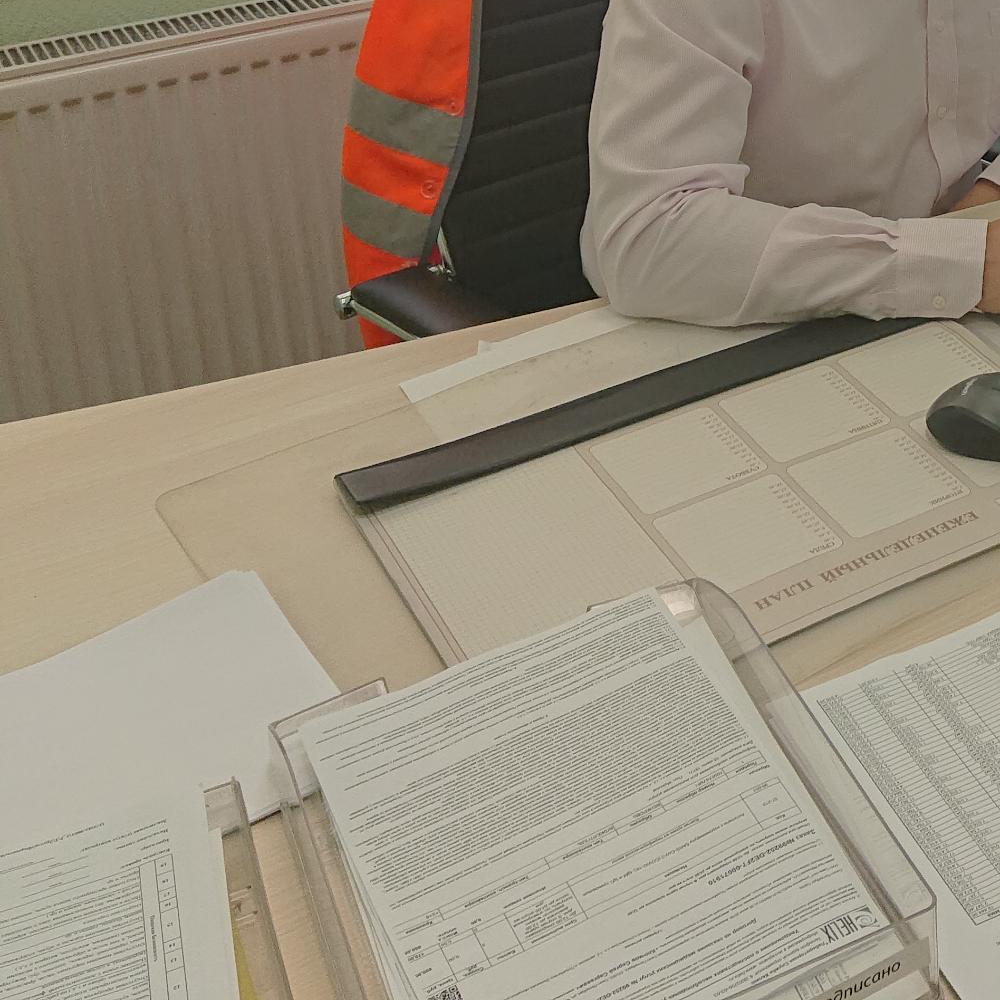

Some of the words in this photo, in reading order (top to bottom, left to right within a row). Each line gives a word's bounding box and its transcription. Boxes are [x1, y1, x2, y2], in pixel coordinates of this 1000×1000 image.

[820, 510, 979, 584] ЕЖЕНЕДЕЛЬНЫЙ
[753, 578, 816, 610] ПЛАН
[820, 914, 858, 944] HELIX
[827, 961, 901, 1000] дписано
